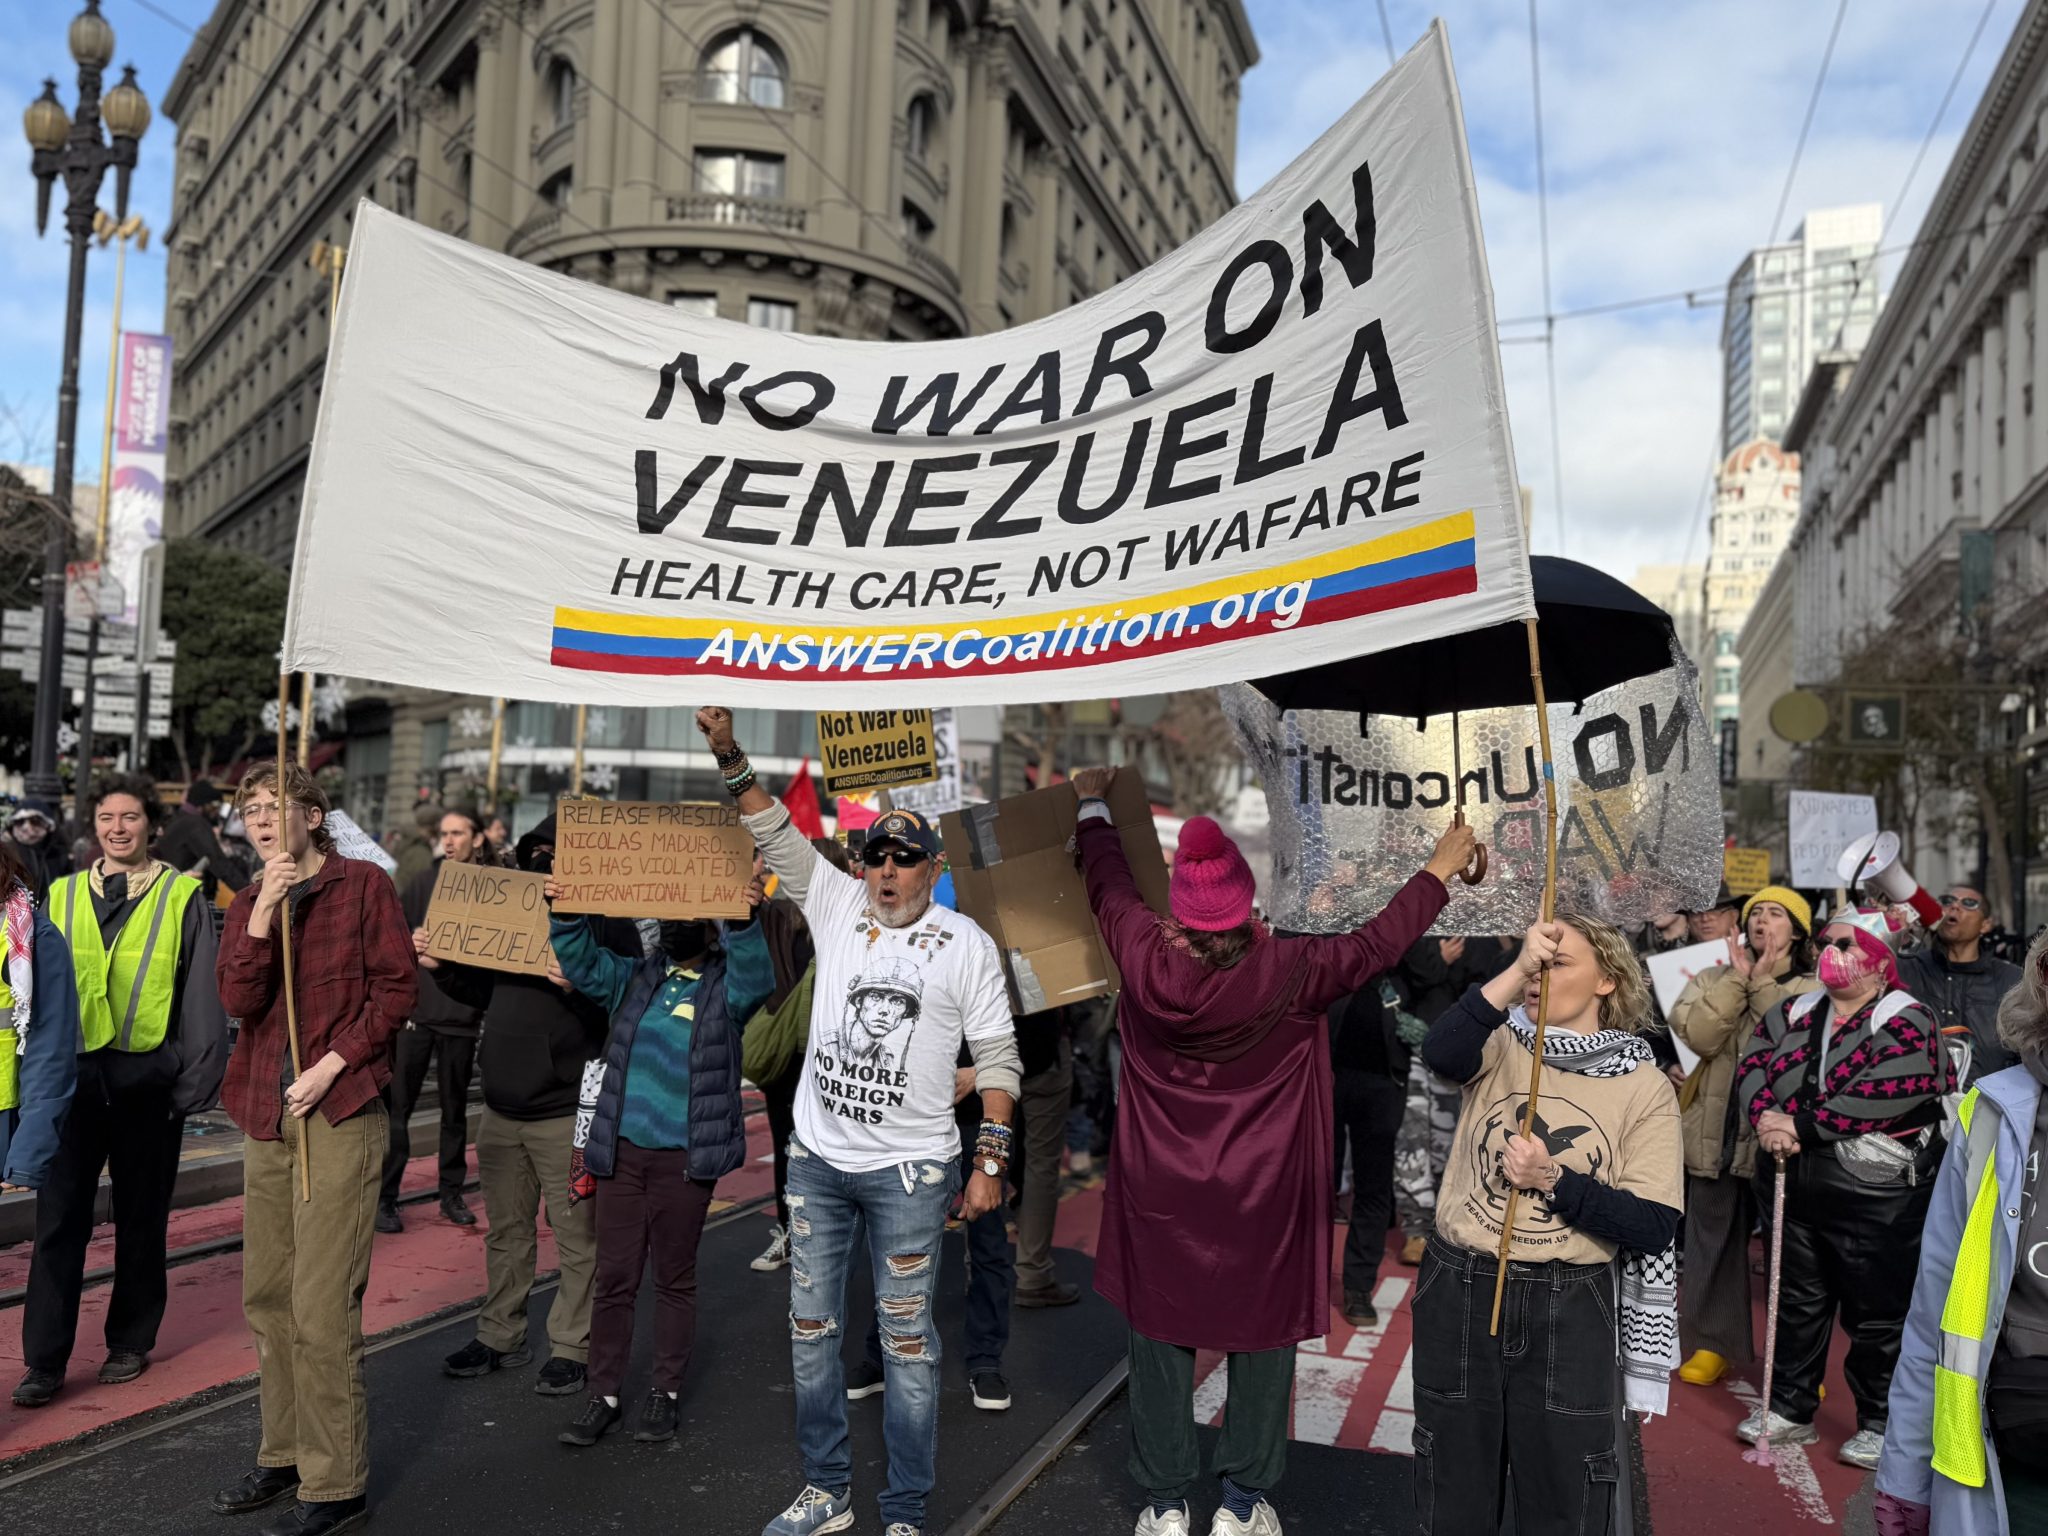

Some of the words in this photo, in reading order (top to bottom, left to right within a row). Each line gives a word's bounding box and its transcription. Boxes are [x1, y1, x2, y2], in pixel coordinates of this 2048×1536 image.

[645, 351, 836, 431] NO
[871, 311, 1167, 436] WAR
[1205, 160, 1377, 354] ON
[635, 318, 1409, 548] VENEZUELA
[610, 557, 835, 610] HEALTH
[849, 561, 1007, 611] CARE,
[1027, 536, 1150, 598] NOT
[1164, 451, 1425, 571] WAFARE
[696, 578, 1313, 673] ANSWERCoalition.org
[820, 711, 854, 740] Not
[858, 710, 897, 733] War
[825, 730, 927, 770] Venezuela
[834, 767, 923, 790] ANSWERCoalition.org
[563, 805, 650, 826] RELEASE
[656, 805, 741, 827] PRESIDE
[563, 831, 642, 851] NICOLAS
[651, 832, 741, 856] MADURO...
[561, 856, 594, 876] U.S.
[600, 857, 633, 877] HAS
[639, 856, 738, 878] VIOLATED
[438, 870, 511, 905] HANDS
[559, 882, 692, 904] INTERNATIONAL
[428, 918, 549, 967] VENEZUELA
[815, 1047, 834, 1072] NO
[840, 1060, 909, 1088] MORE
[815, 1071, 905, 1107] FOREIGN
[821, 1095, 884, 1125] WARS
[1463, 1201, 1486, 1226] PEACE
[1483, 1223, 1504, 1237] AND
[1511, 1233, 1552, 1245] REEDOM
